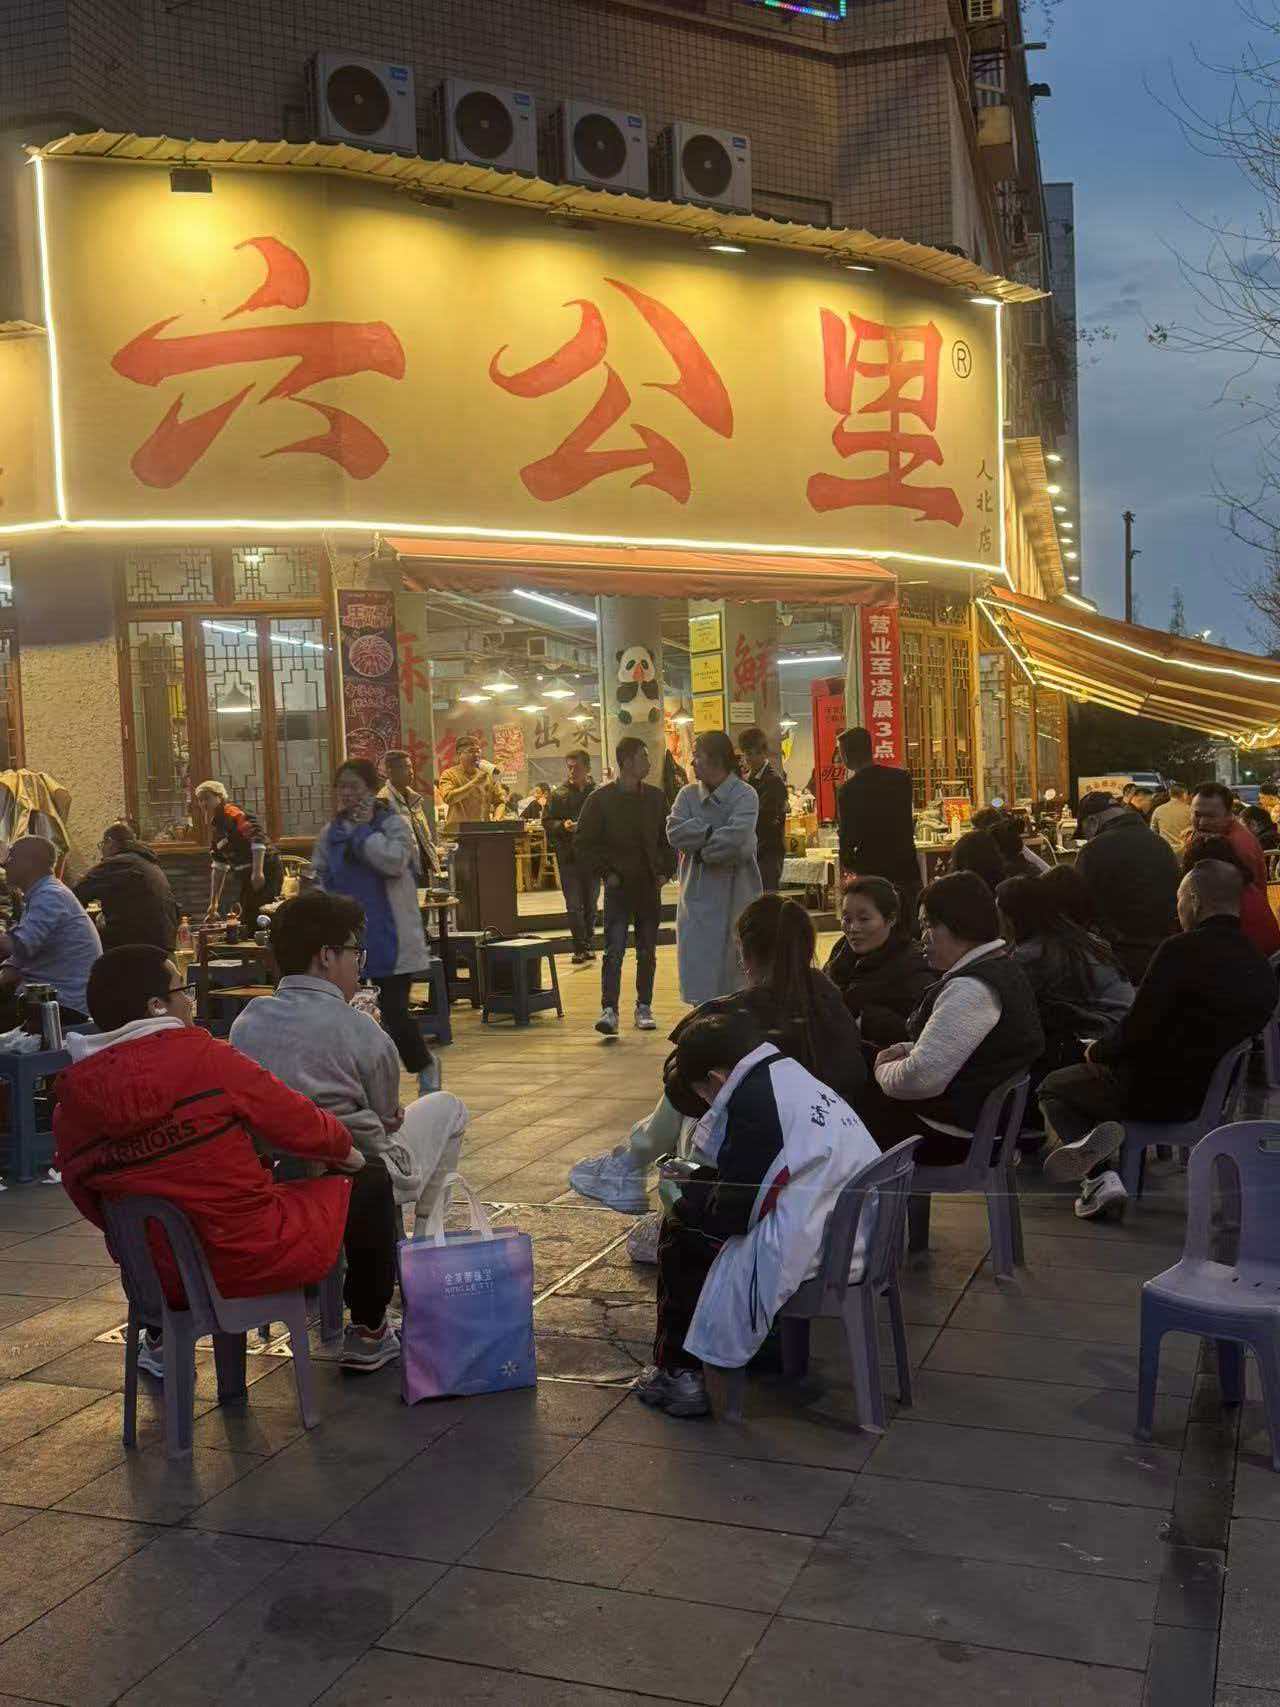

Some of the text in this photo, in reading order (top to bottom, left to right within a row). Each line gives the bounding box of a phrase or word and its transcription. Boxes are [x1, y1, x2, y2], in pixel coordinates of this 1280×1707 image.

[110, 236, 964, 527] 六公里
[977, 458, 993, 553] 人北店
[868, 614, 896, 759] 营业至凌晨3点
